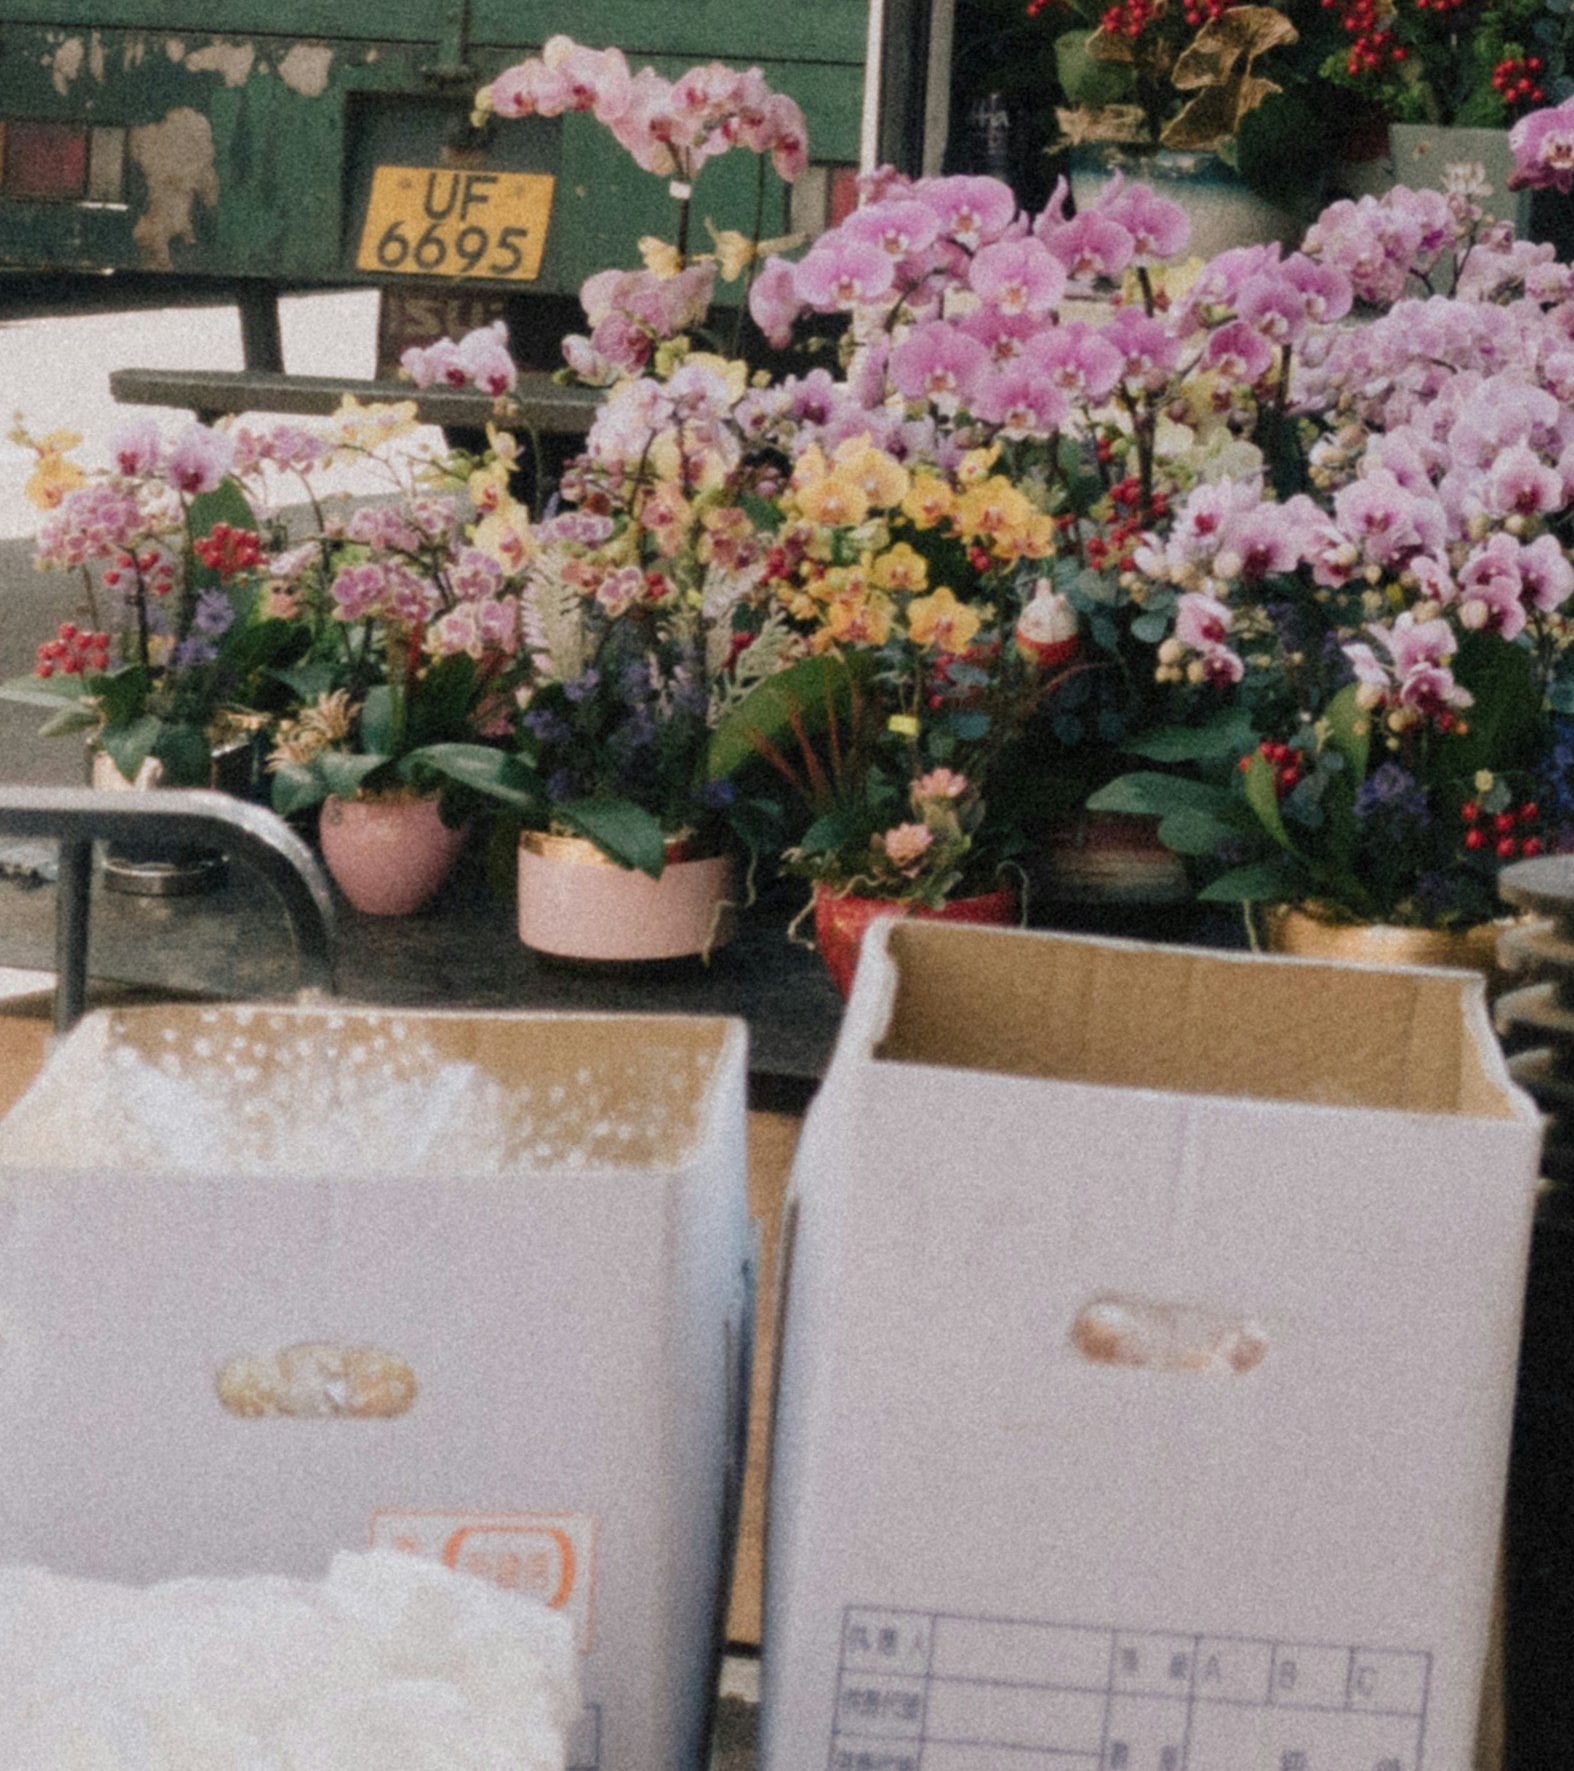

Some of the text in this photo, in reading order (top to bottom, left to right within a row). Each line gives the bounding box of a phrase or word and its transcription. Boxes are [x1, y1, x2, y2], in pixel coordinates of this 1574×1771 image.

[422, 173, 498, 220] UF
[376, 221, 528, 274] 6695
[1203, 1654, 1222, 1683] A
[1278, 1659, 1298, 1690] B
